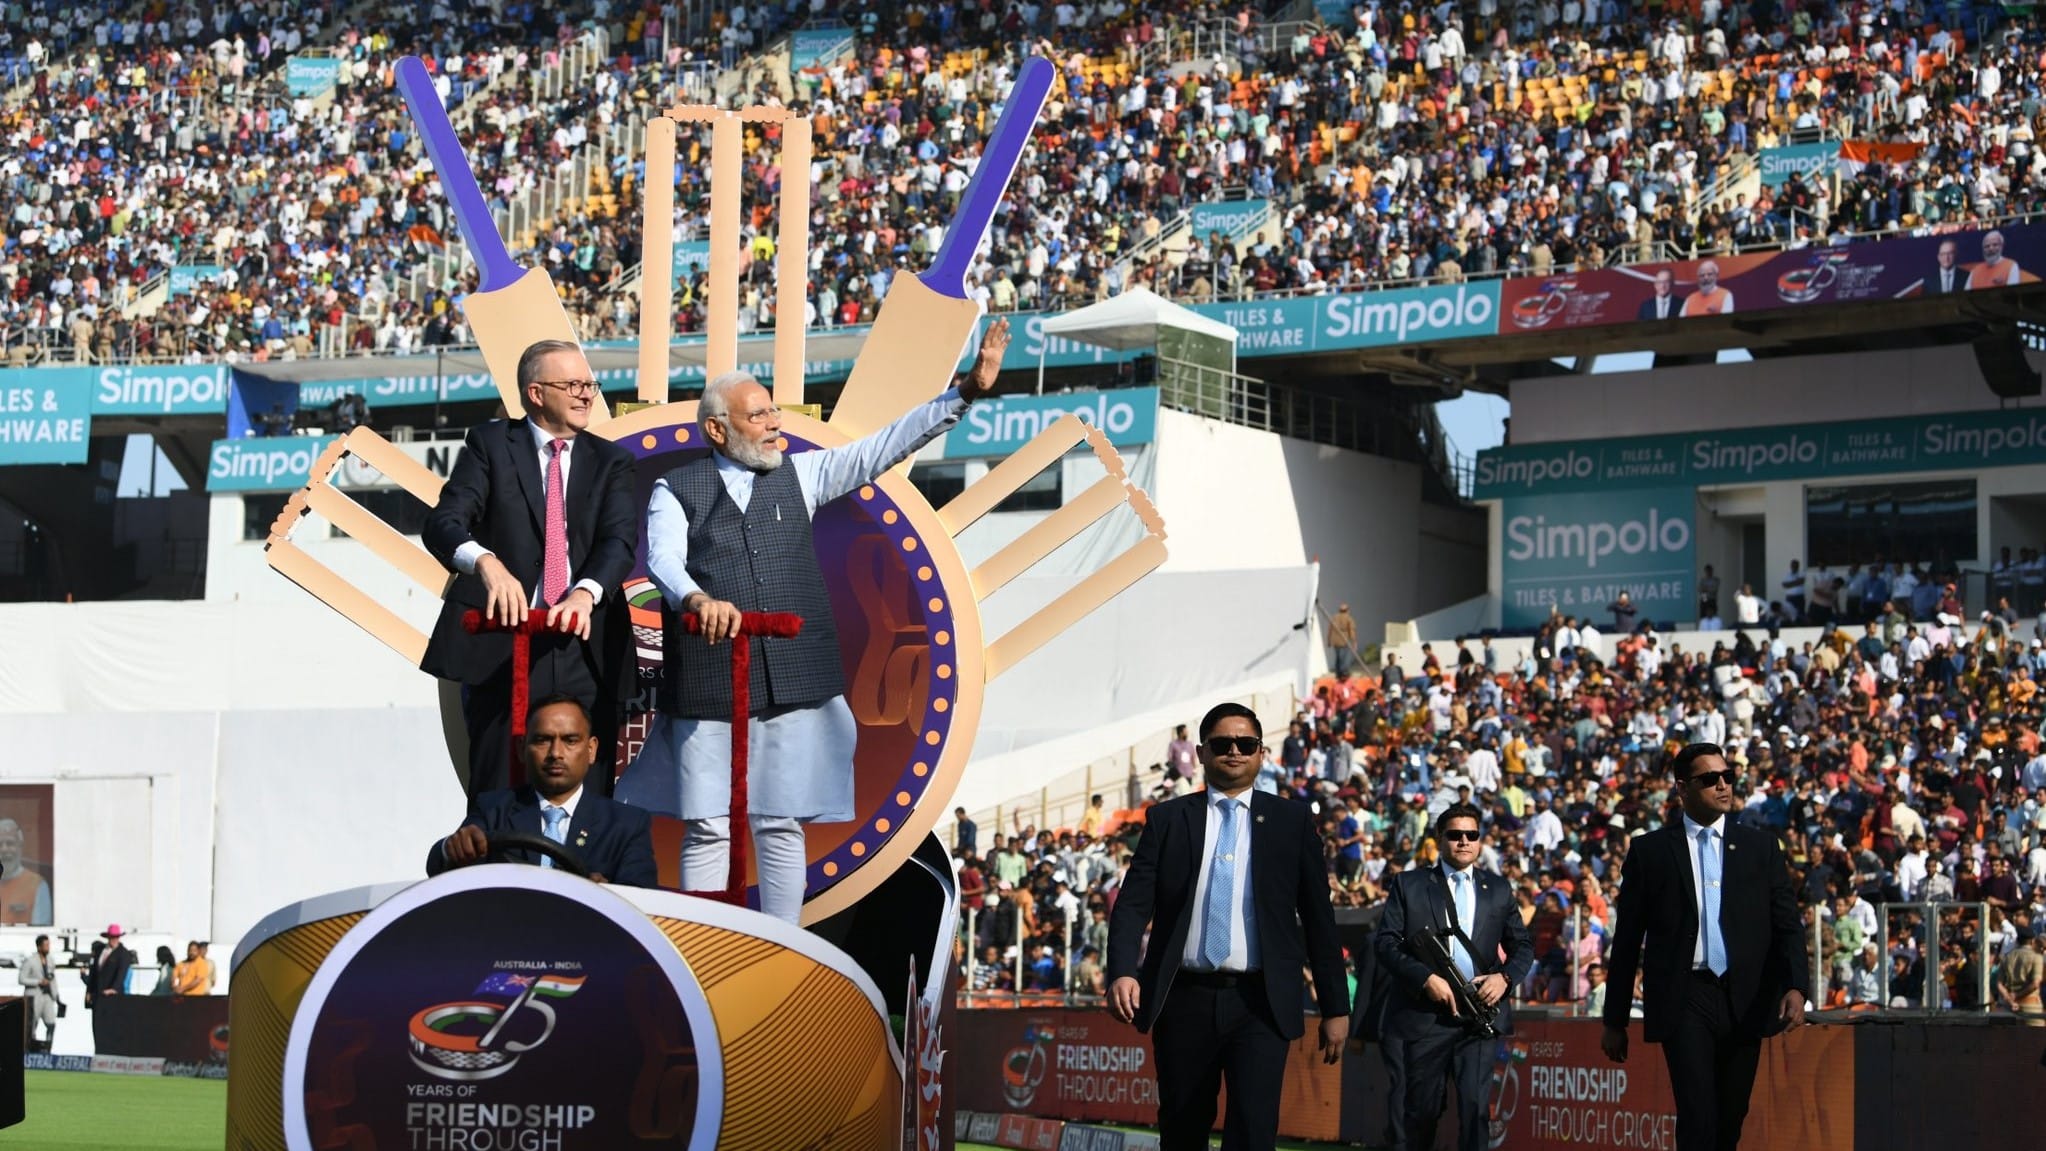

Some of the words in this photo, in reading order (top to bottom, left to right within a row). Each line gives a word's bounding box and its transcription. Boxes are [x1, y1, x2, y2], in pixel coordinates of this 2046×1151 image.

[289, 63, 340, 80] Simpol
[1196, 208, 1256, 231] Simpol
[1224, 308, 1267, 327] TILES
[1273, 308, 1285, 325] &
[1326, 286, 1492, 341] Simpolo
[1239, 328, 1304, 349] HWARE
[0, 388, 34, 412] LES
[42, 390, 58, 412] &
[98, 367, 228, 412] Simpol
[0, 419, 84, 443] HWARE
[212, 442, 319, 483] Simpol
[1693, 434, 1817, 473] Simpolo
[1832, 445, 1906, 464] BATHWARE
[1478, 451, 1593, 487] Simpolo
[1607, 461, 1676, 478] BATHWARE
[1508, 508, 1690, 568] Simpolo
[1515, 588, 1557, 608] TILES
[1563, 586, 1576, 605] &
[493, 961, 547, 969] AUSTRALIA
[1056, 1044, 1146, 1073] FRIENDSHIP
[1530, 1042, 1552, 1057] YEARS
[1554, 1043, 1565, 1058] OF
[407, 1085, 453, 1097] YEARS
[457, 1085, 477, 1097] OF
[1056, 1074, 1128, 1104] THROUGH
[1530, 1065, 1628, 1103] FRIENDSHIP
[406, 1103, 596, 1128] FRIENDSHIP
[1530, 1105, 1608, 1145] THROUGH
[407, 1128, 562, 1151] THROUGH
